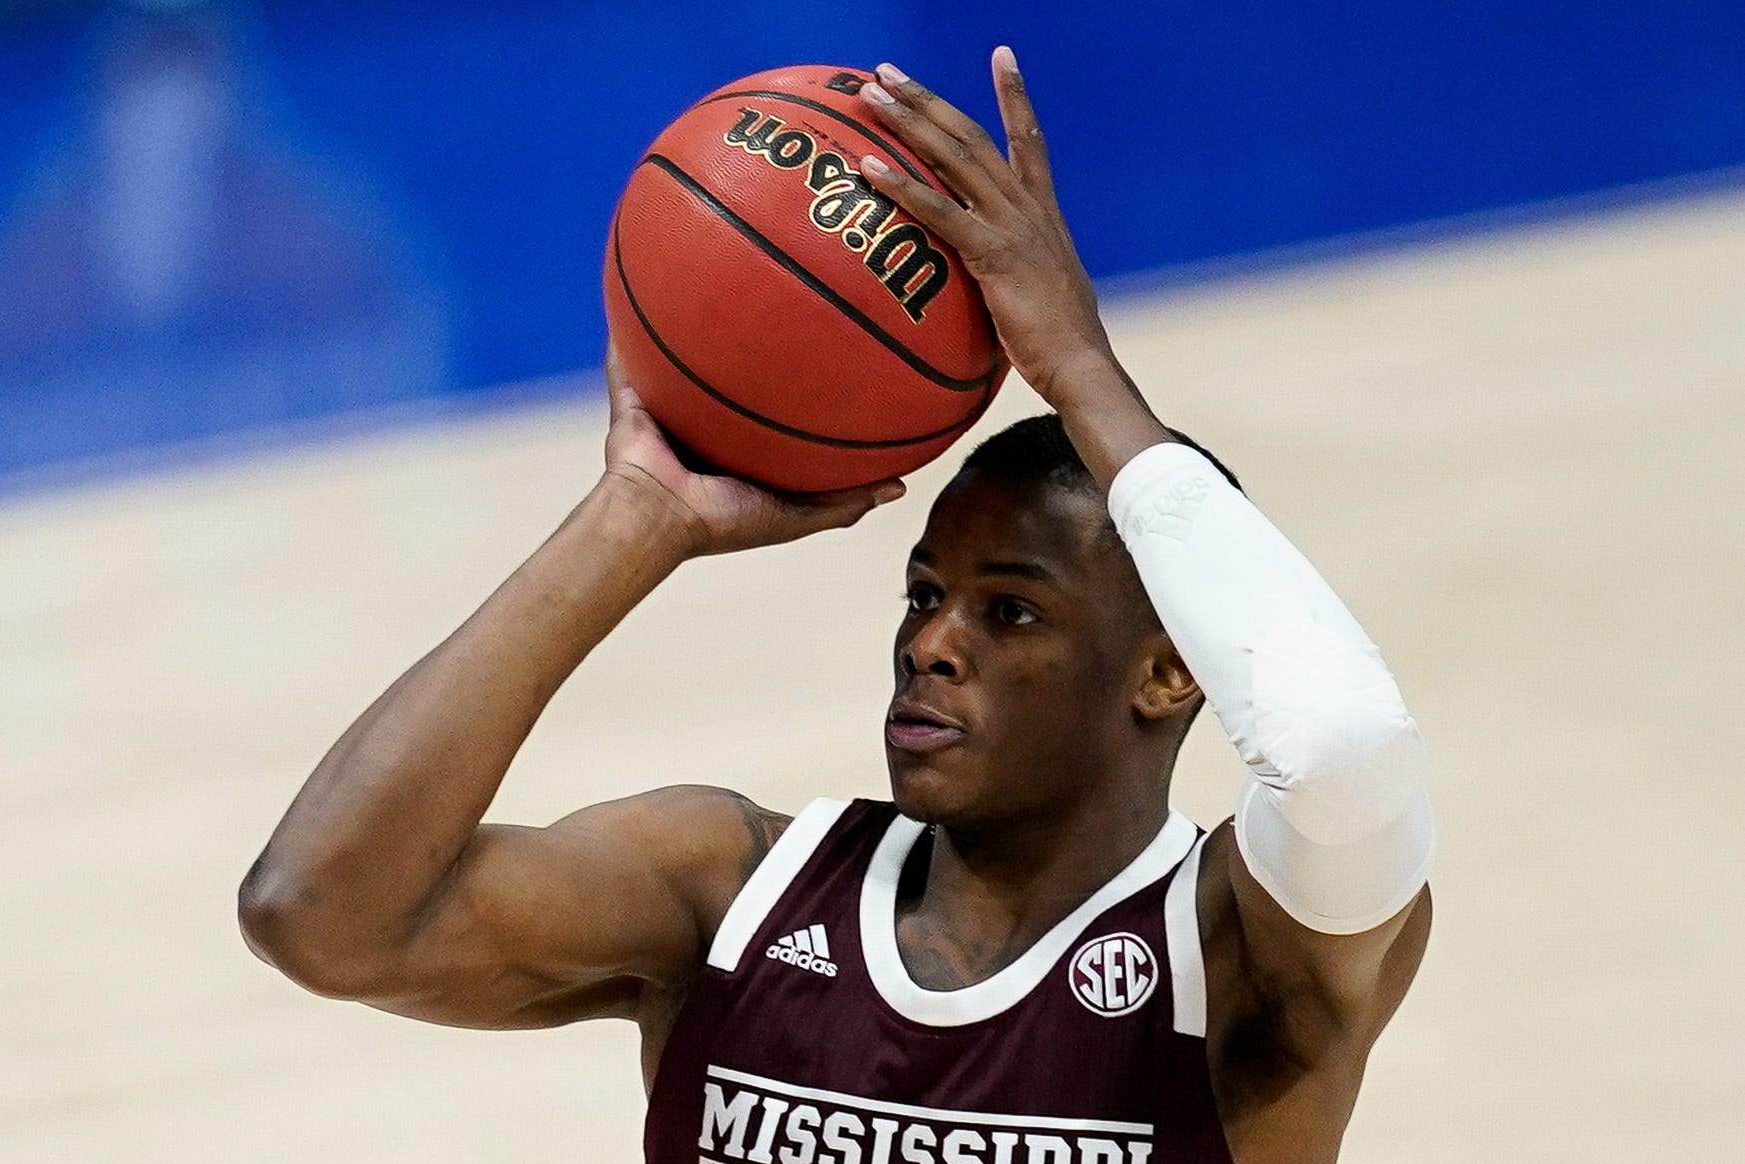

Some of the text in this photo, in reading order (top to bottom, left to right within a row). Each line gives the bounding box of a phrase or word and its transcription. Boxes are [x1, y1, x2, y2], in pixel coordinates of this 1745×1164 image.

[723, 106, 951, 326] Wilson
[765, 942, 839, 978] adidas
[1076, 938, 1152, 1011] SEC
